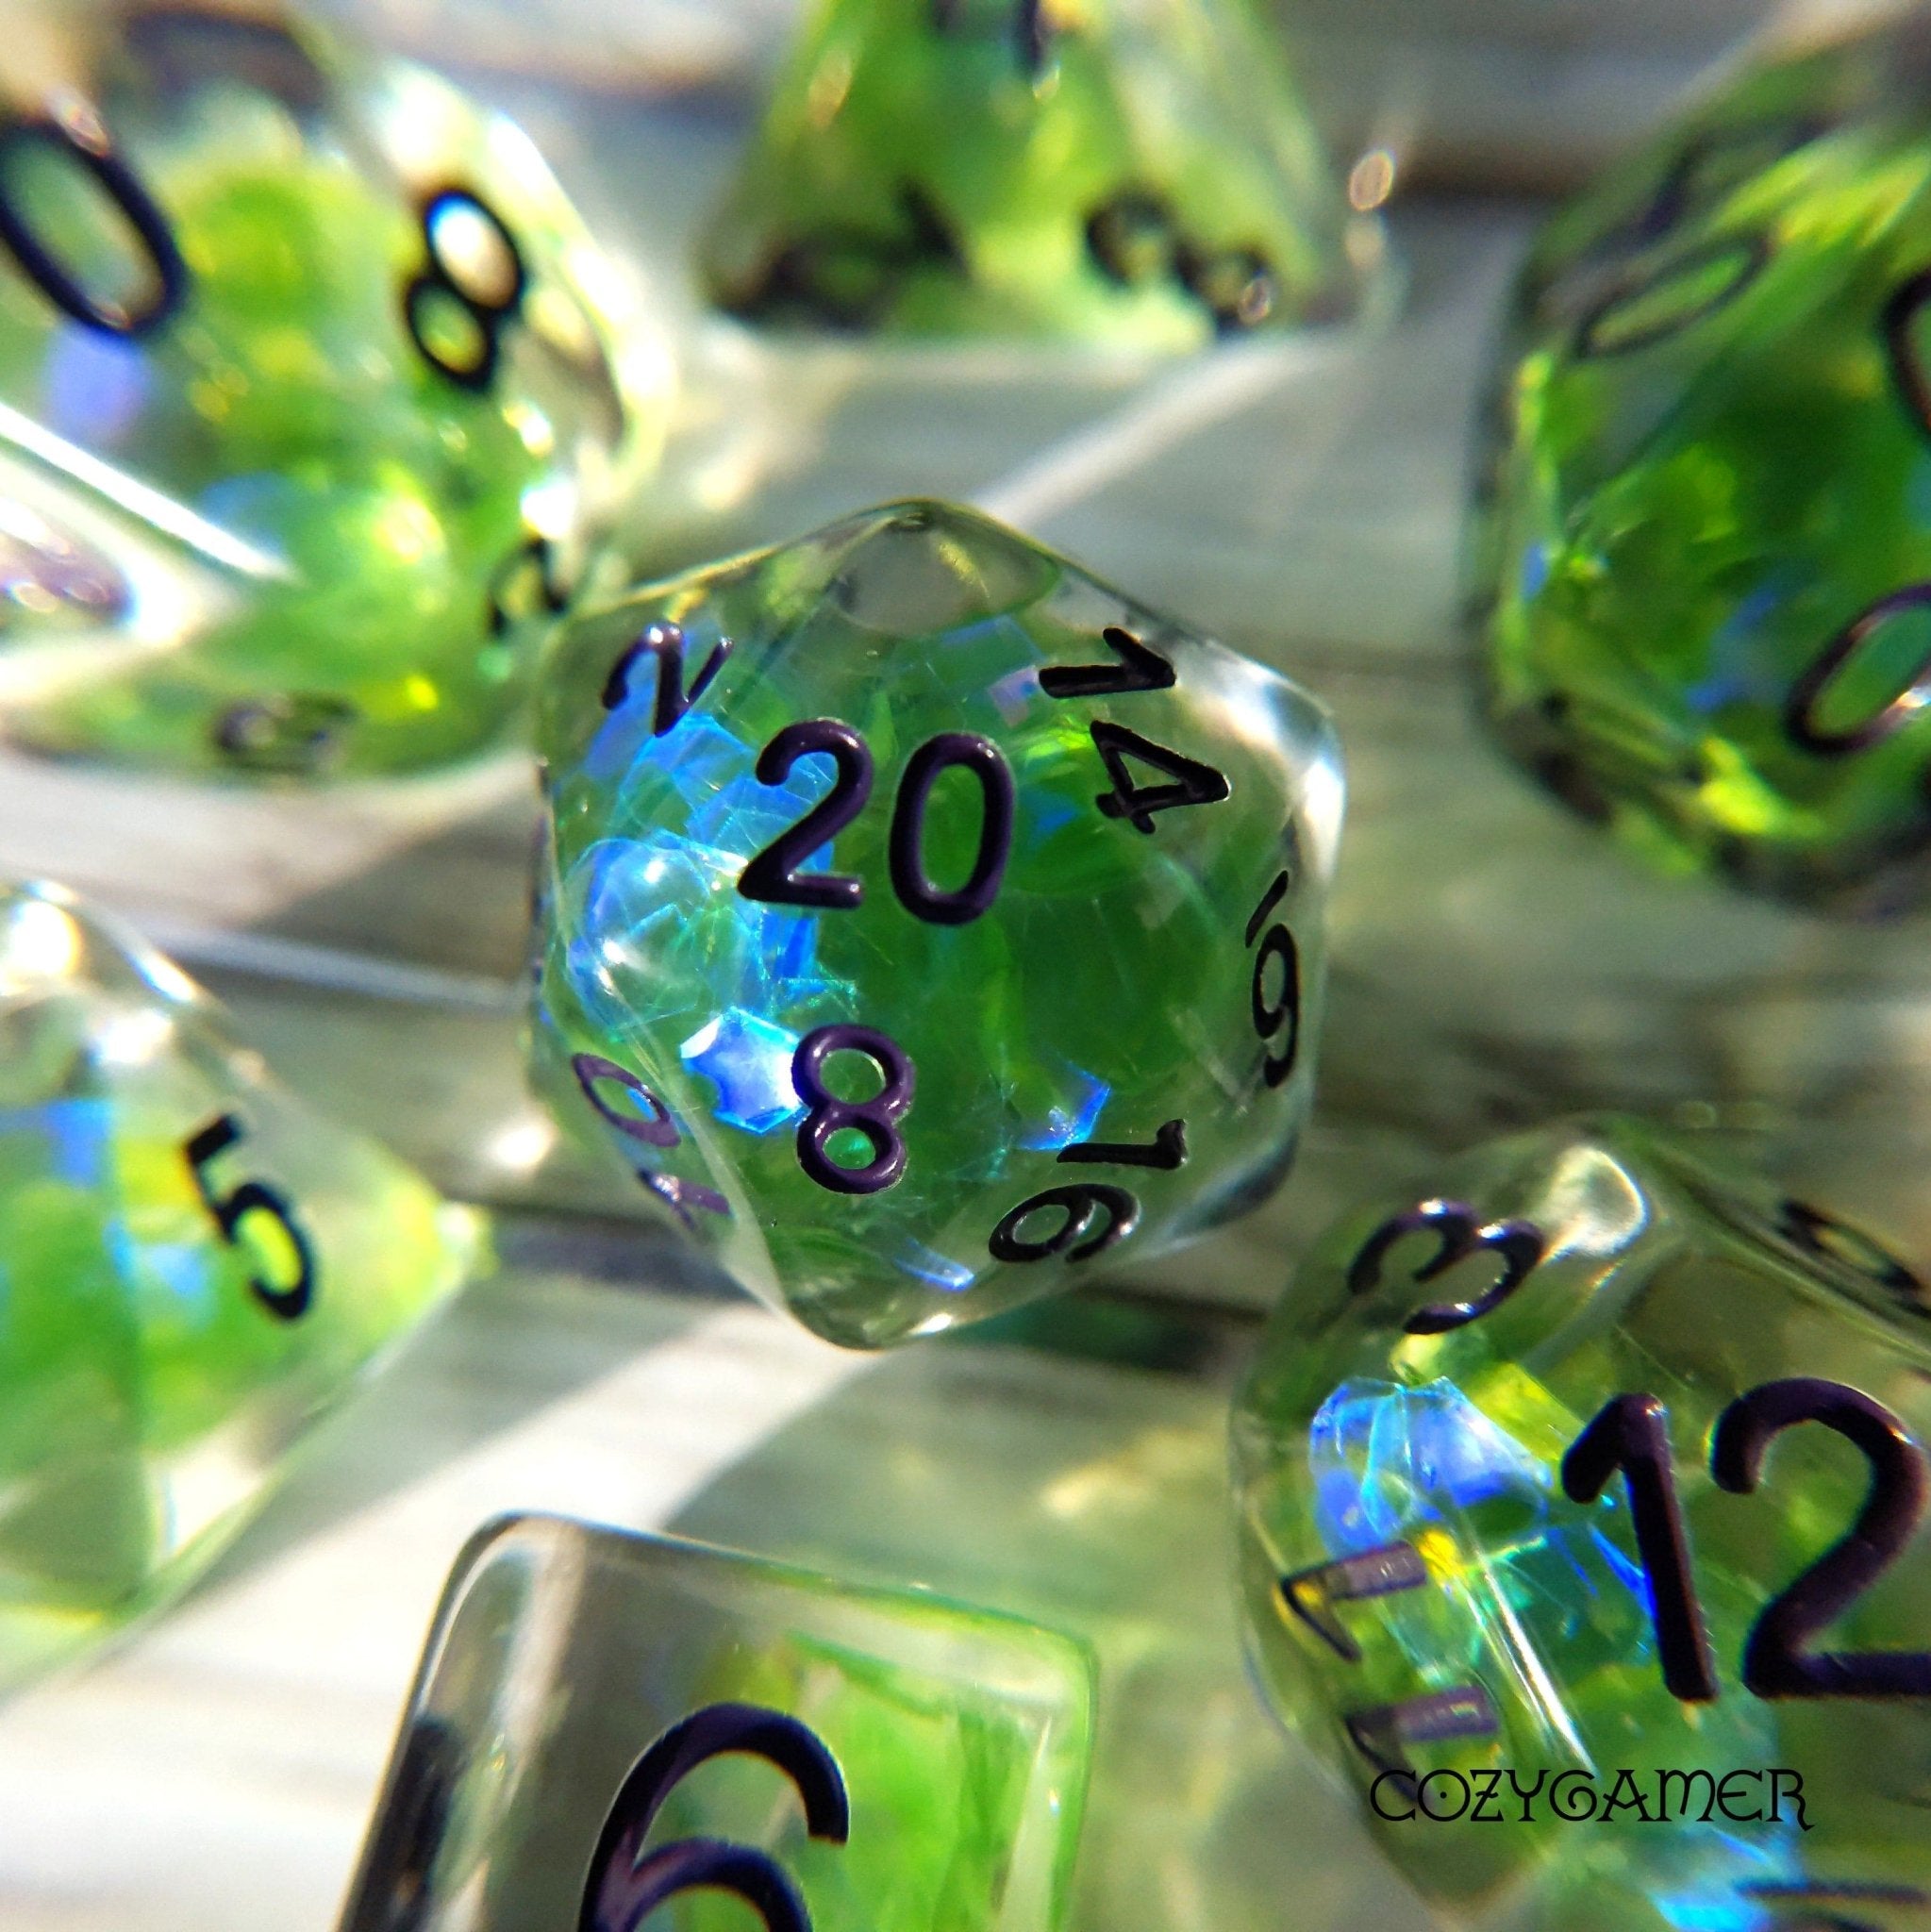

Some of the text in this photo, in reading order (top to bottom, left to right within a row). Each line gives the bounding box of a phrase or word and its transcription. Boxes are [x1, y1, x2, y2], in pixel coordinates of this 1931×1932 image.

[402, 187, 532, 394] 8
[601, 621, 735, 739] 2
[1038, 626, 1232, 835] 14
[737, 715, 1016, 927] 20
[791, 1023, 917, 1196] 8
[181, 1113, 319, 1324] 5
[1346, 1197, 1548, 1336] 3
[1561, 1377, 1931, 1705] 12
[577, 1702, 851, 1932] 6
